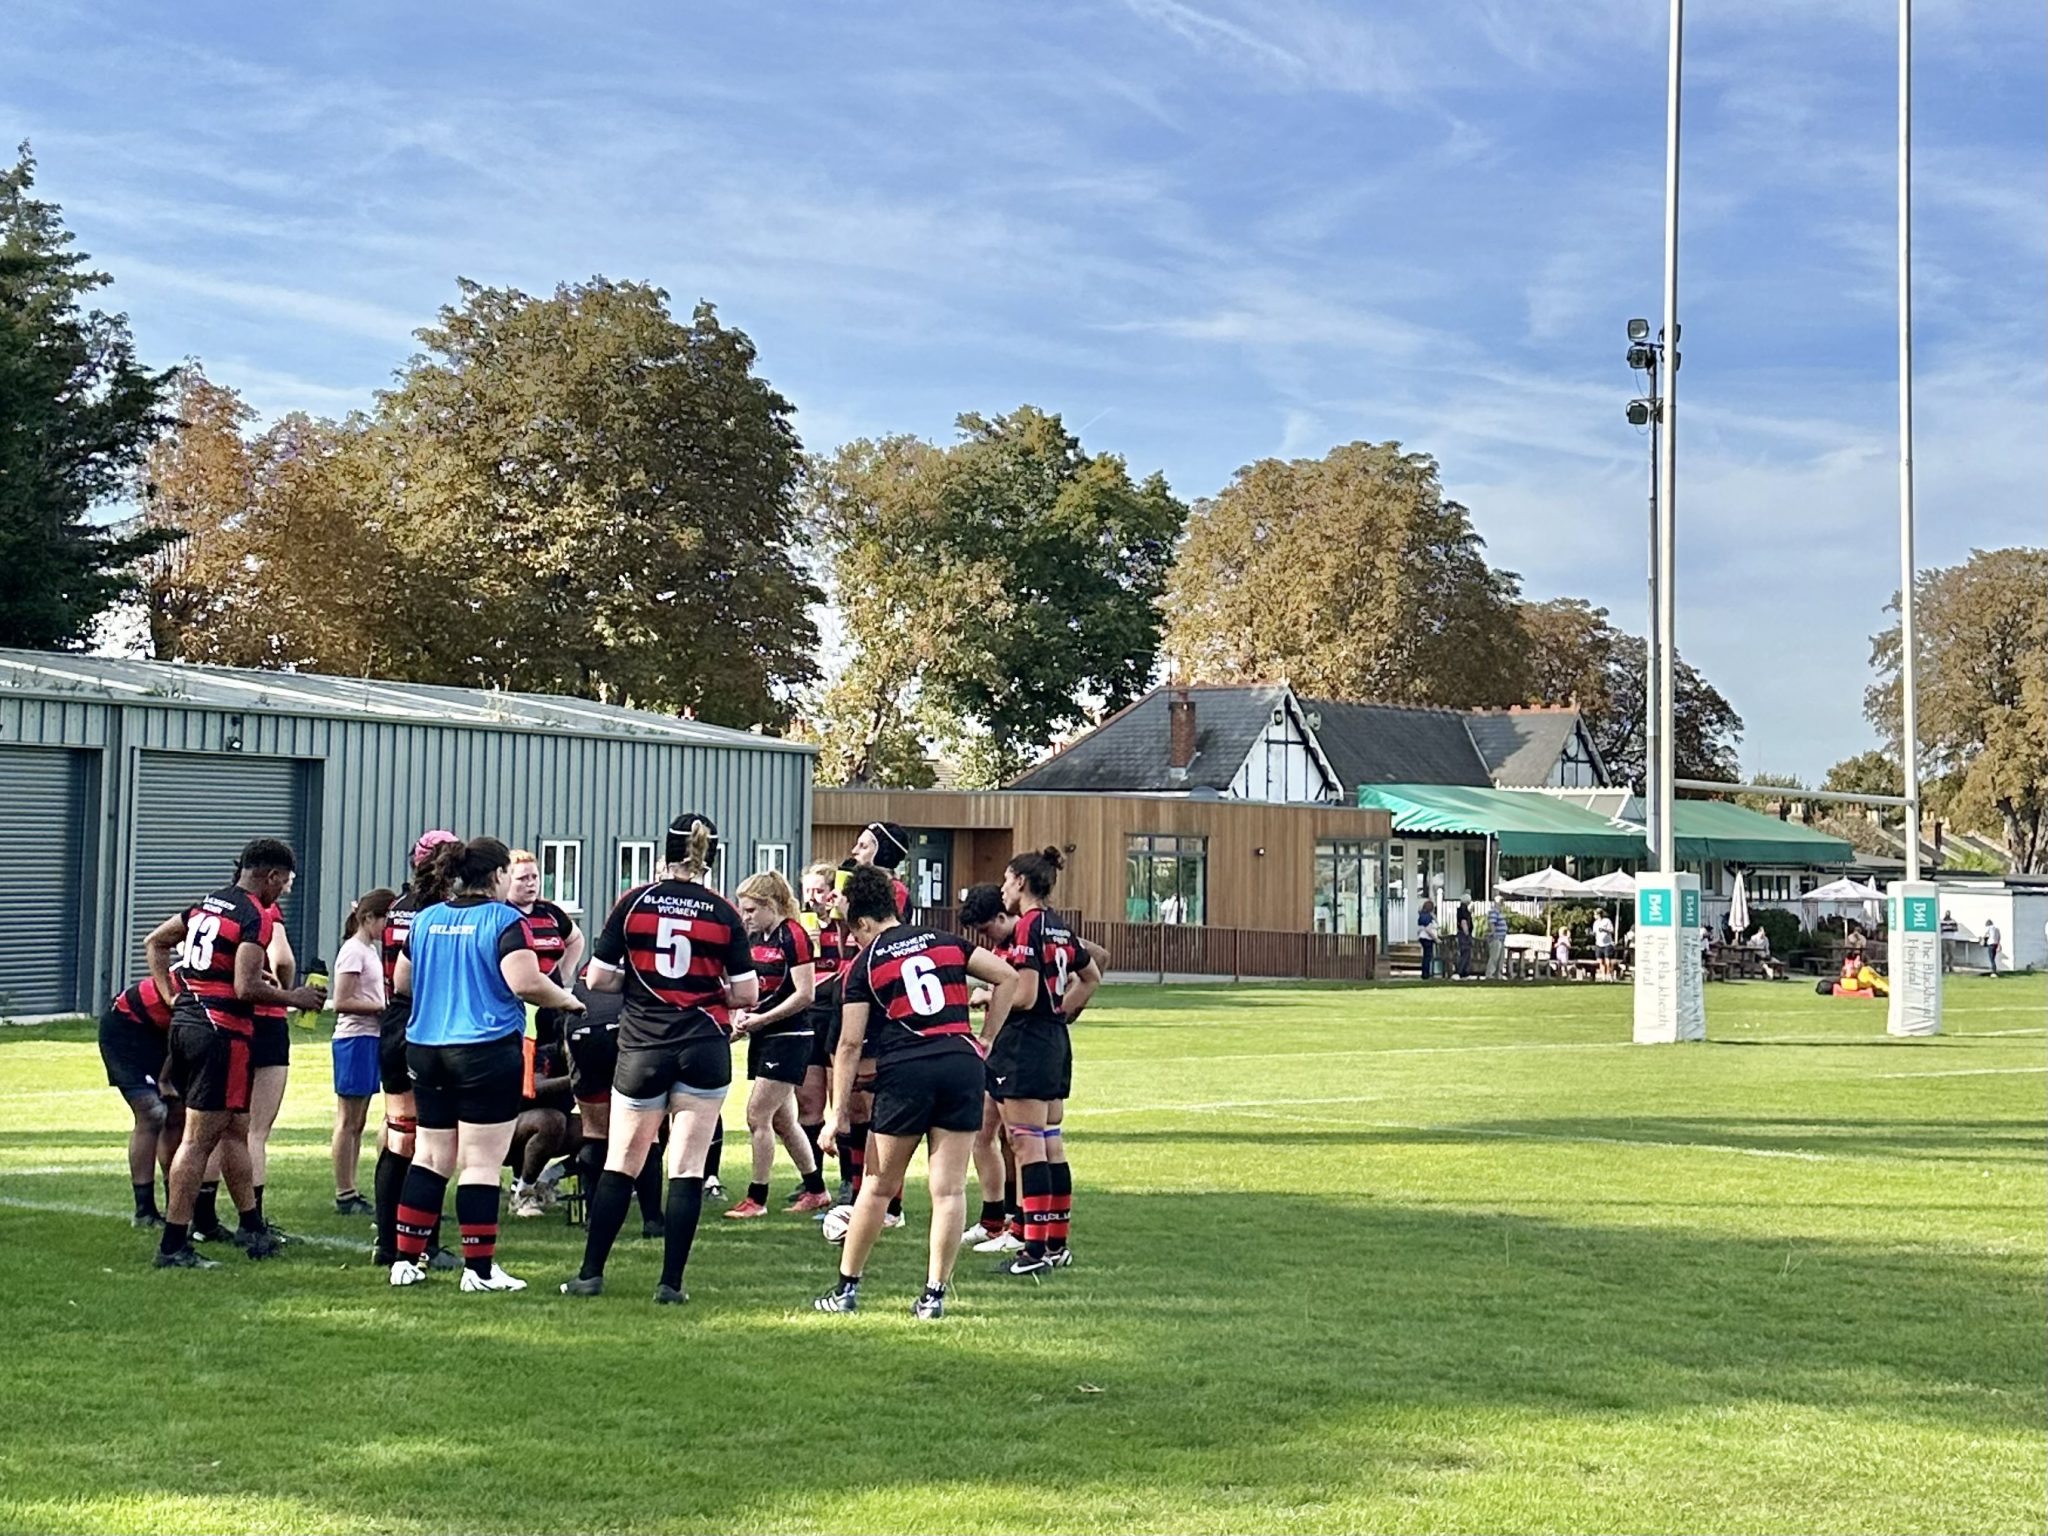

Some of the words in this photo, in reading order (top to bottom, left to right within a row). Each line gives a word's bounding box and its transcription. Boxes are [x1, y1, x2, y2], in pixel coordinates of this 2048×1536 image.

[643, 895, 714, 912] BLACKHEATH
[657, 905, 698, 918] WOMEN
[1913, 902, 1928, 928] BMI
[182, 911, 221, 971] 13
[655, 916, 693, 979] 5
[875, 933, 937, 957] BLACKHEATH
[891, 941, 928, 958] WOMEN
[1922, 938, 1934, 959] The
[900, 955, 946, 1016] 6
